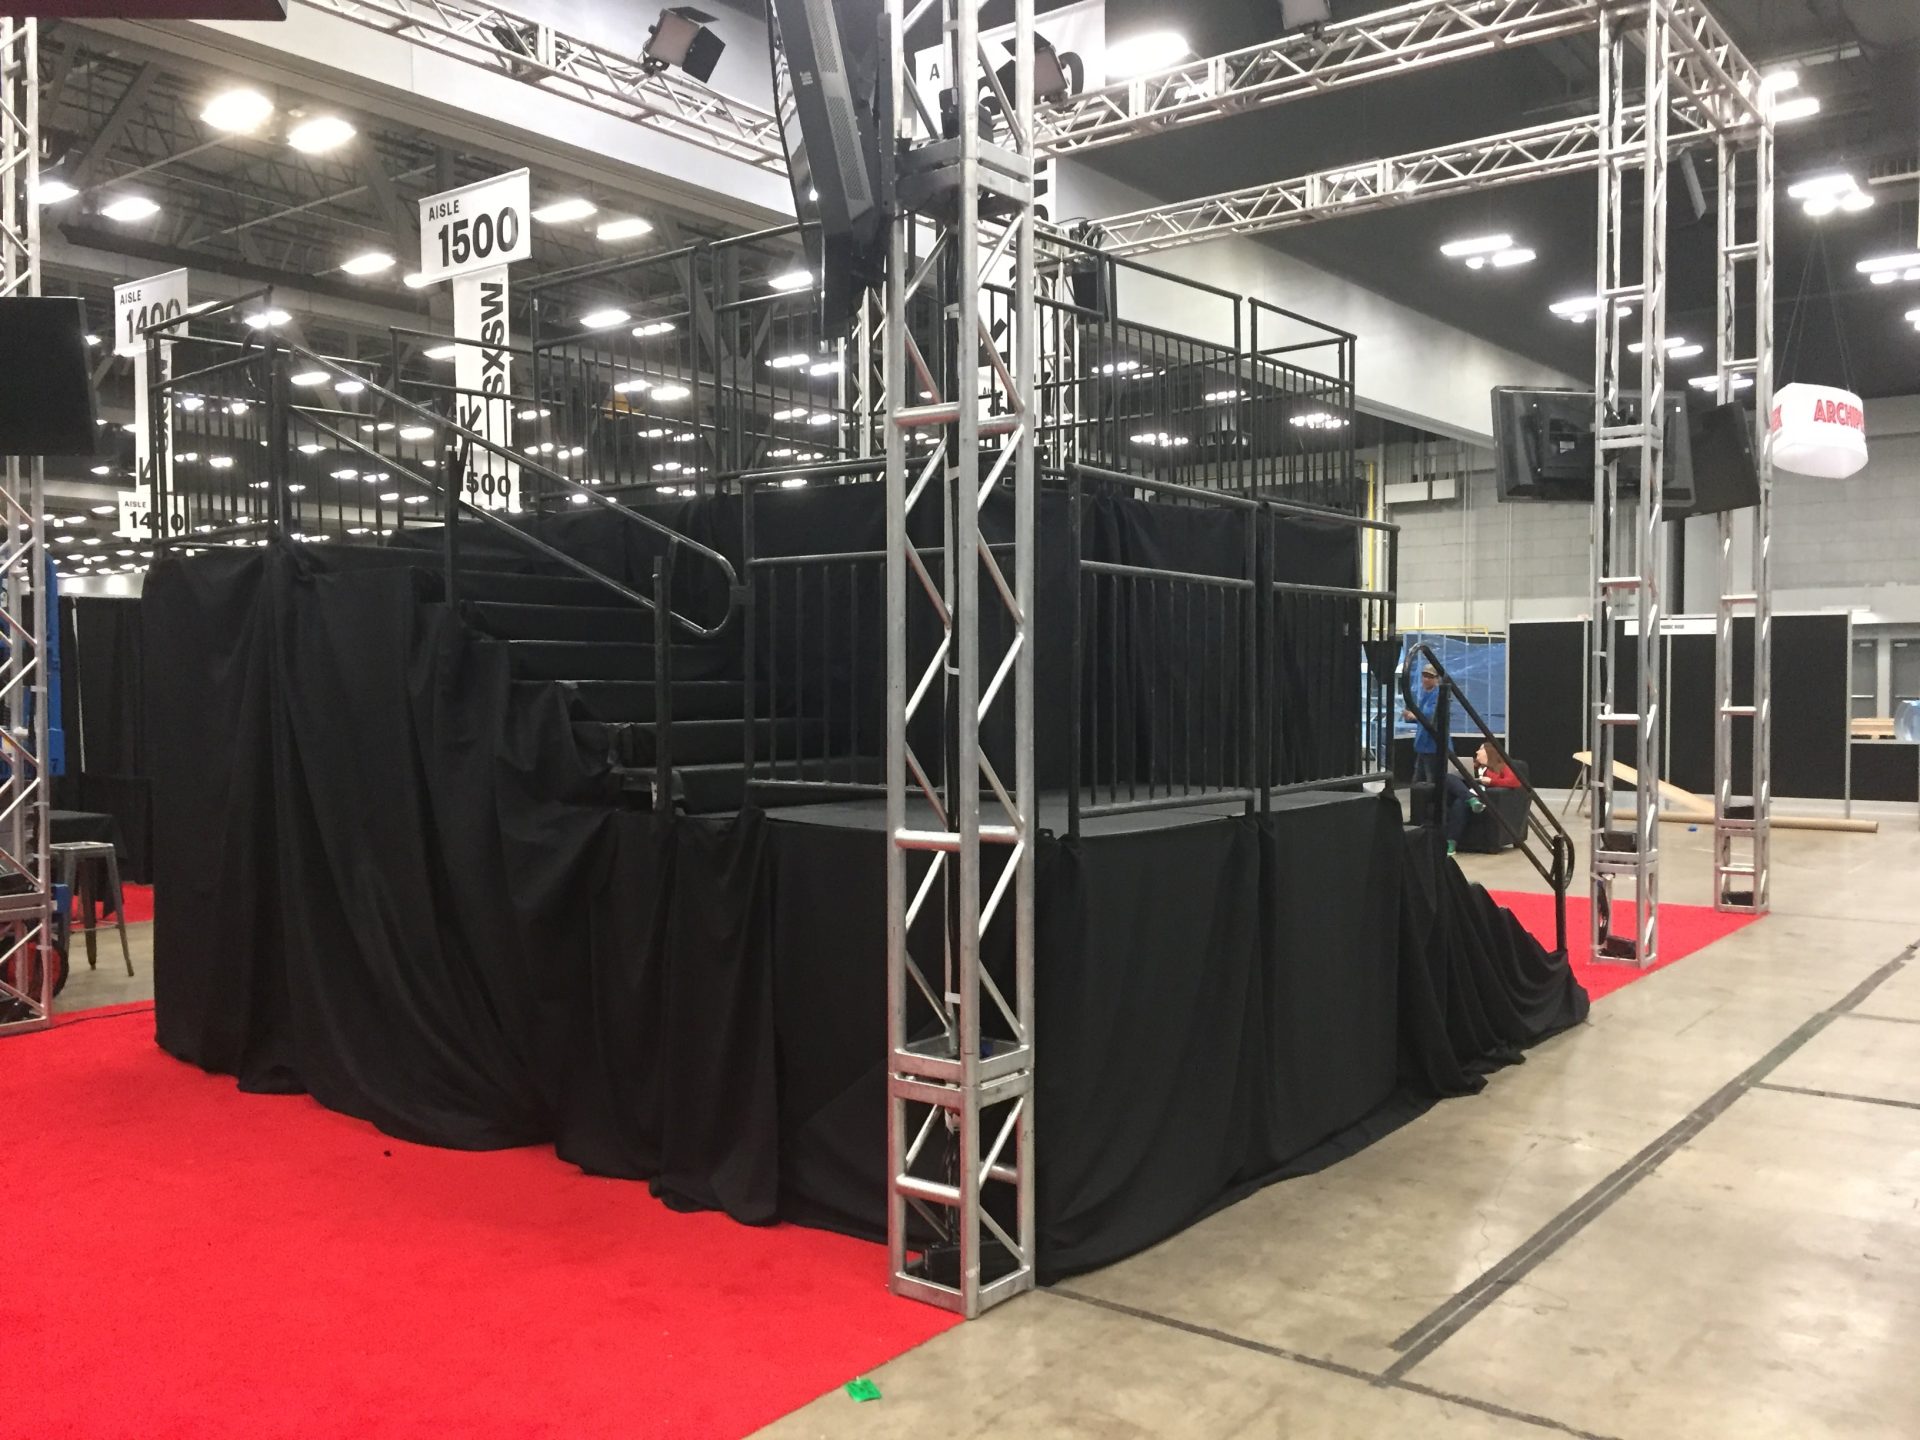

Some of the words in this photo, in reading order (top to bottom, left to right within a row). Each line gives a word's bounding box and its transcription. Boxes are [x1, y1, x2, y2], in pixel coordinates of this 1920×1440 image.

[429, 200, 460, 221] AISLE
[438, 207, 519, 267] 1500
[120, 289, 142, 305] AISLE
[481, 282, 505, 400] SXSW
[465, 471, 511, 497] 500
[129, 511, 184, 530] 140
